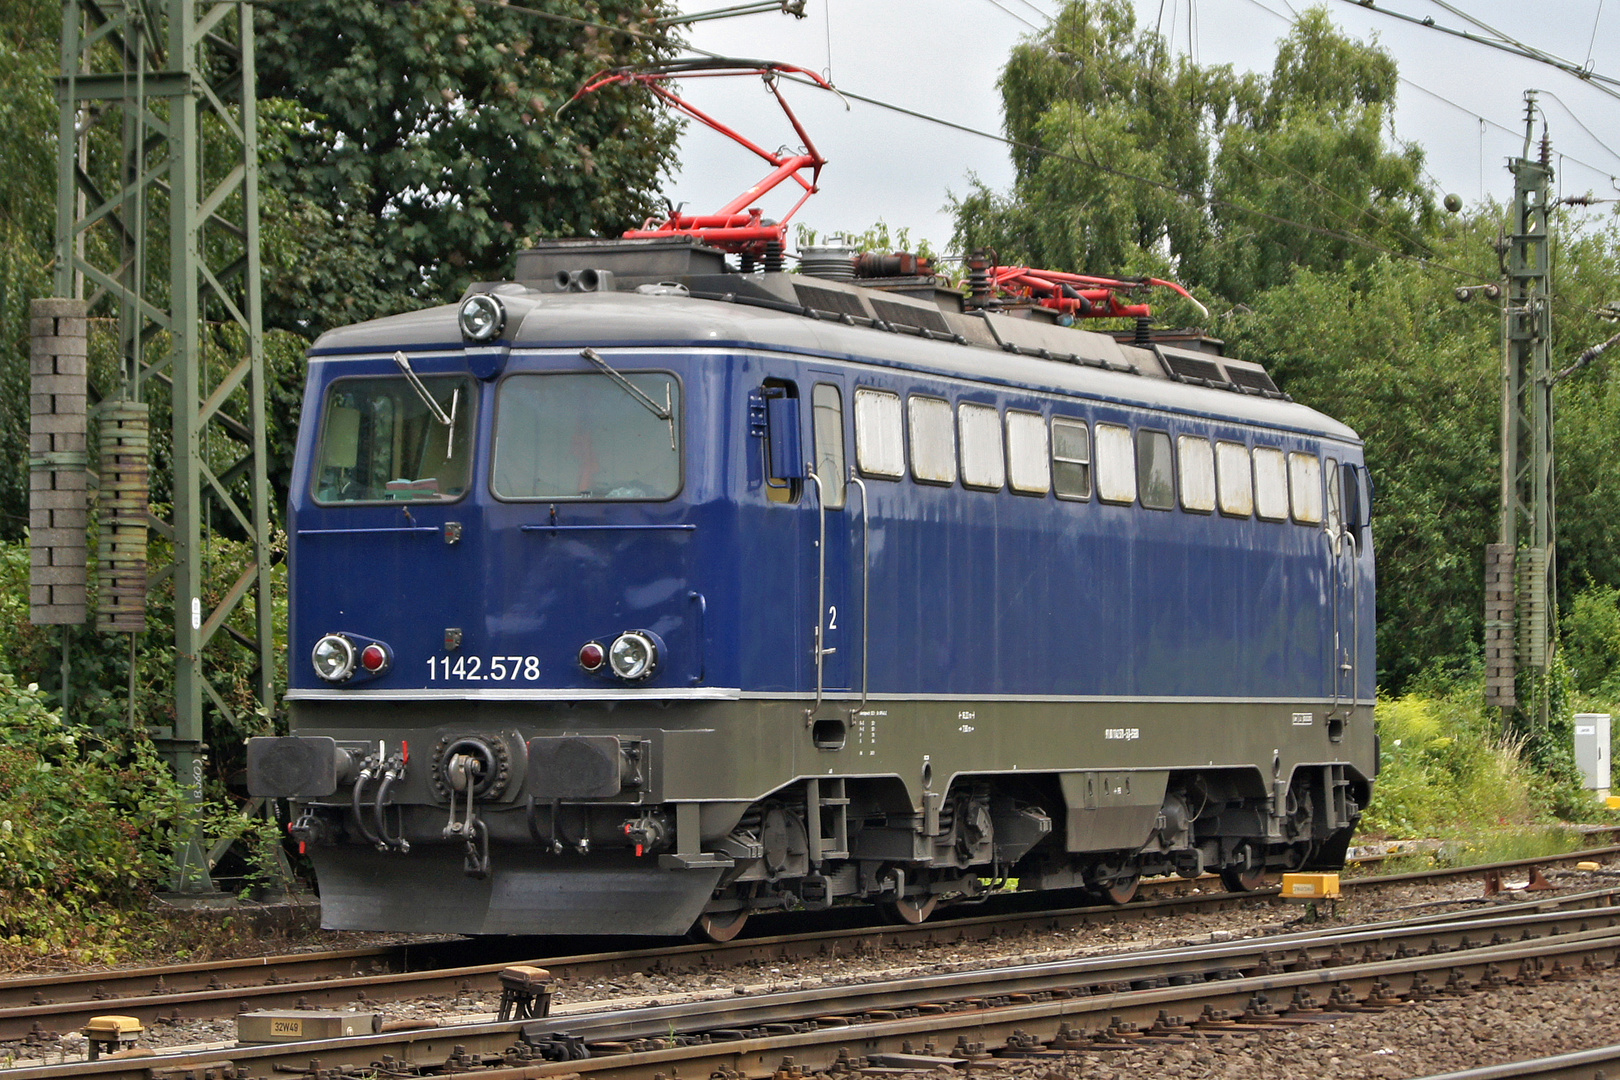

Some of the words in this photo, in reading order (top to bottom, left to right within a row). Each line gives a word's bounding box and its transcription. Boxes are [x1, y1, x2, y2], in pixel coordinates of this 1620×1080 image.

[828, 605, 837, 630] 2
[426, 655, 541, 681] 1142.578
[274, 1022, 299, 1033] 32W49
